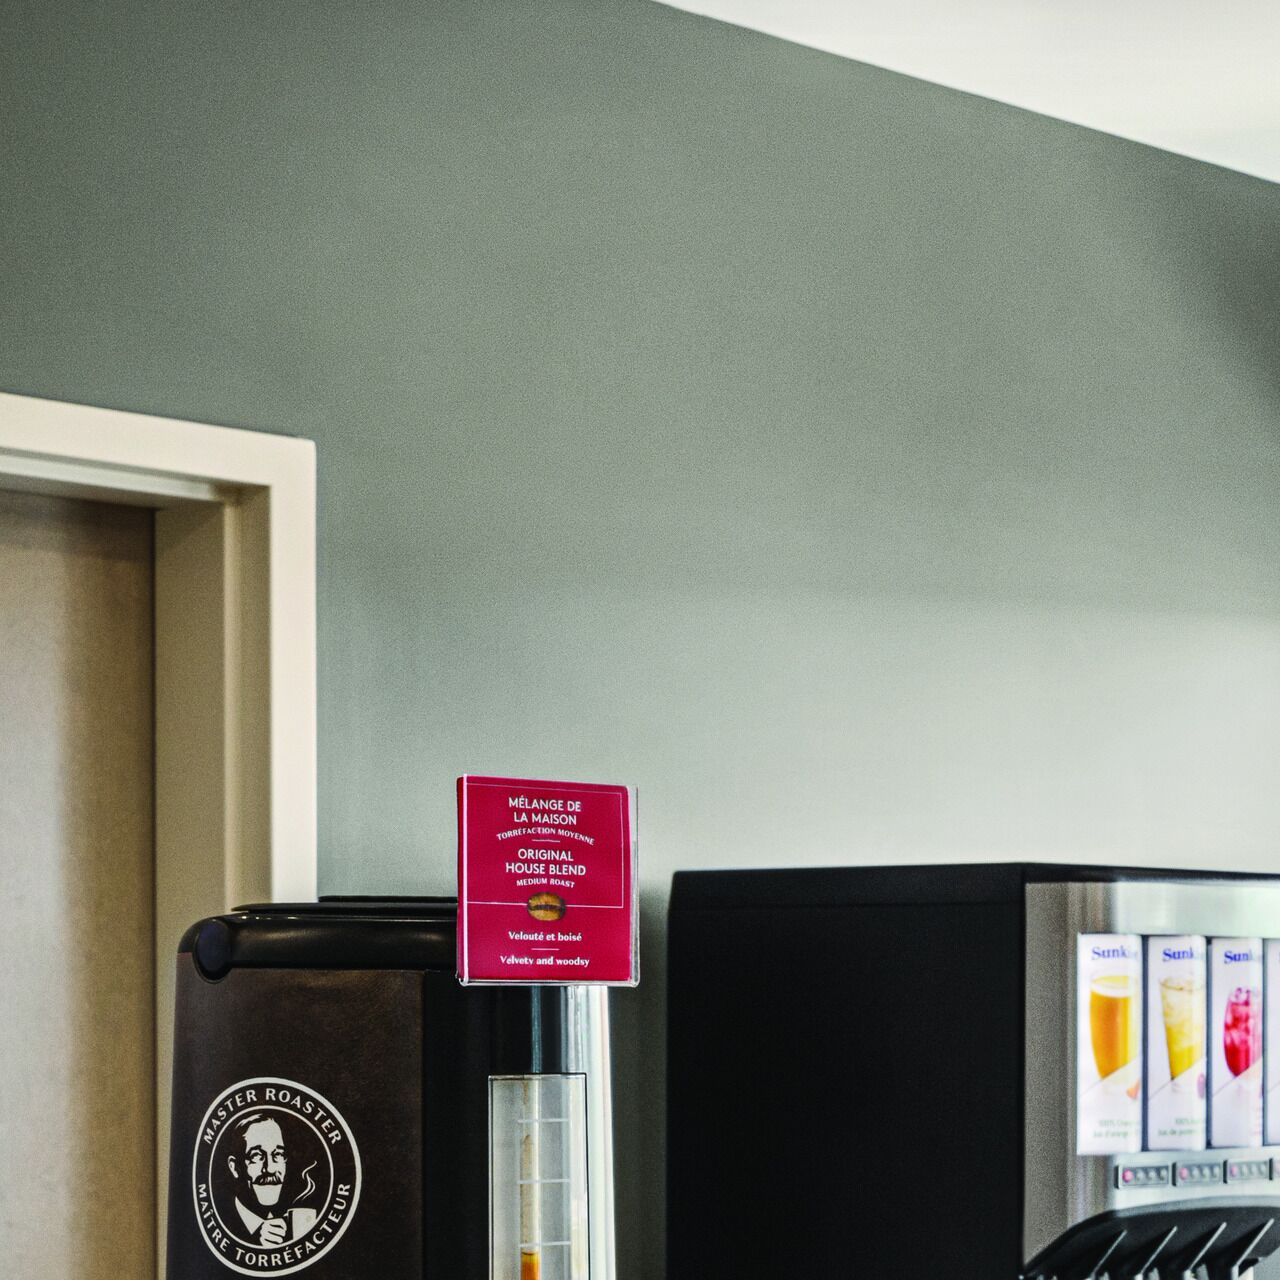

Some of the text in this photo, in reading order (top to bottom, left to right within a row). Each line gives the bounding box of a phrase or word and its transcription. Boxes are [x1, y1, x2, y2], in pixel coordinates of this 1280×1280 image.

[508, 794, 582, 812] MÉLANGE DE
[513, 812, 577, 826] LA MAISON
[496, 827, 595, 846] TORRÉFACTION MOYENNE
[517, 848, 574, 861] ORIGINAL
[505, 862, 586, 876] HOUSE BLEND
[516, 878, 576, 889] MEDIUM ROAST
[508, 931, 582, 942] Velouté et boisé
[1091, 945, 1134, 960] Sunk
[500, 955, 590, 967] Velvety and woodsy
[203, 1088, 342, 1145] MASTER ROASTER
[198, 1183, 351, 1267] MAÎTRE TORRÉFACTEUR
